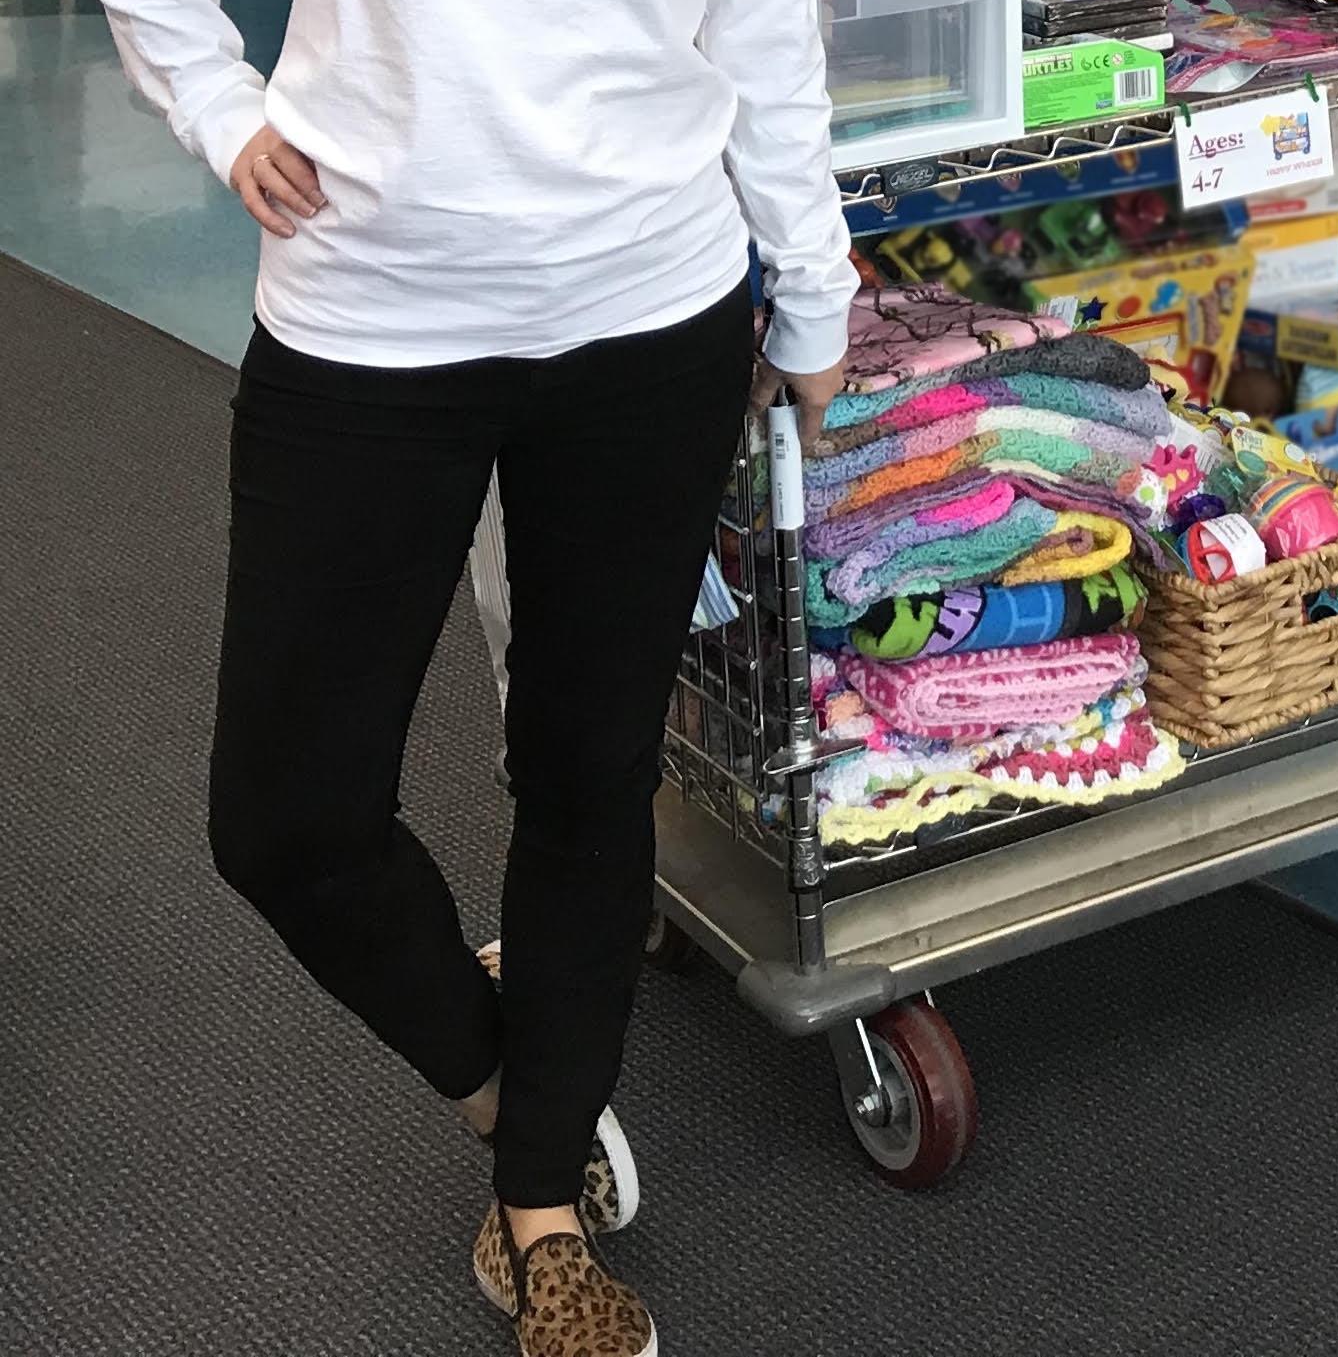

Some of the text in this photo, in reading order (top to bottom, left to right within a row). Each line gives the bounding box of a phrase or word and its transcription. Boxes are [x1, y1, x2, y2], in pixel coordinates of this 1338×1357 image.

[1023, 59, 1073, 77] URTLES
[1189, 132, 1244, 158] Ages:
[1192, 167, 1224, 193] 4-7
